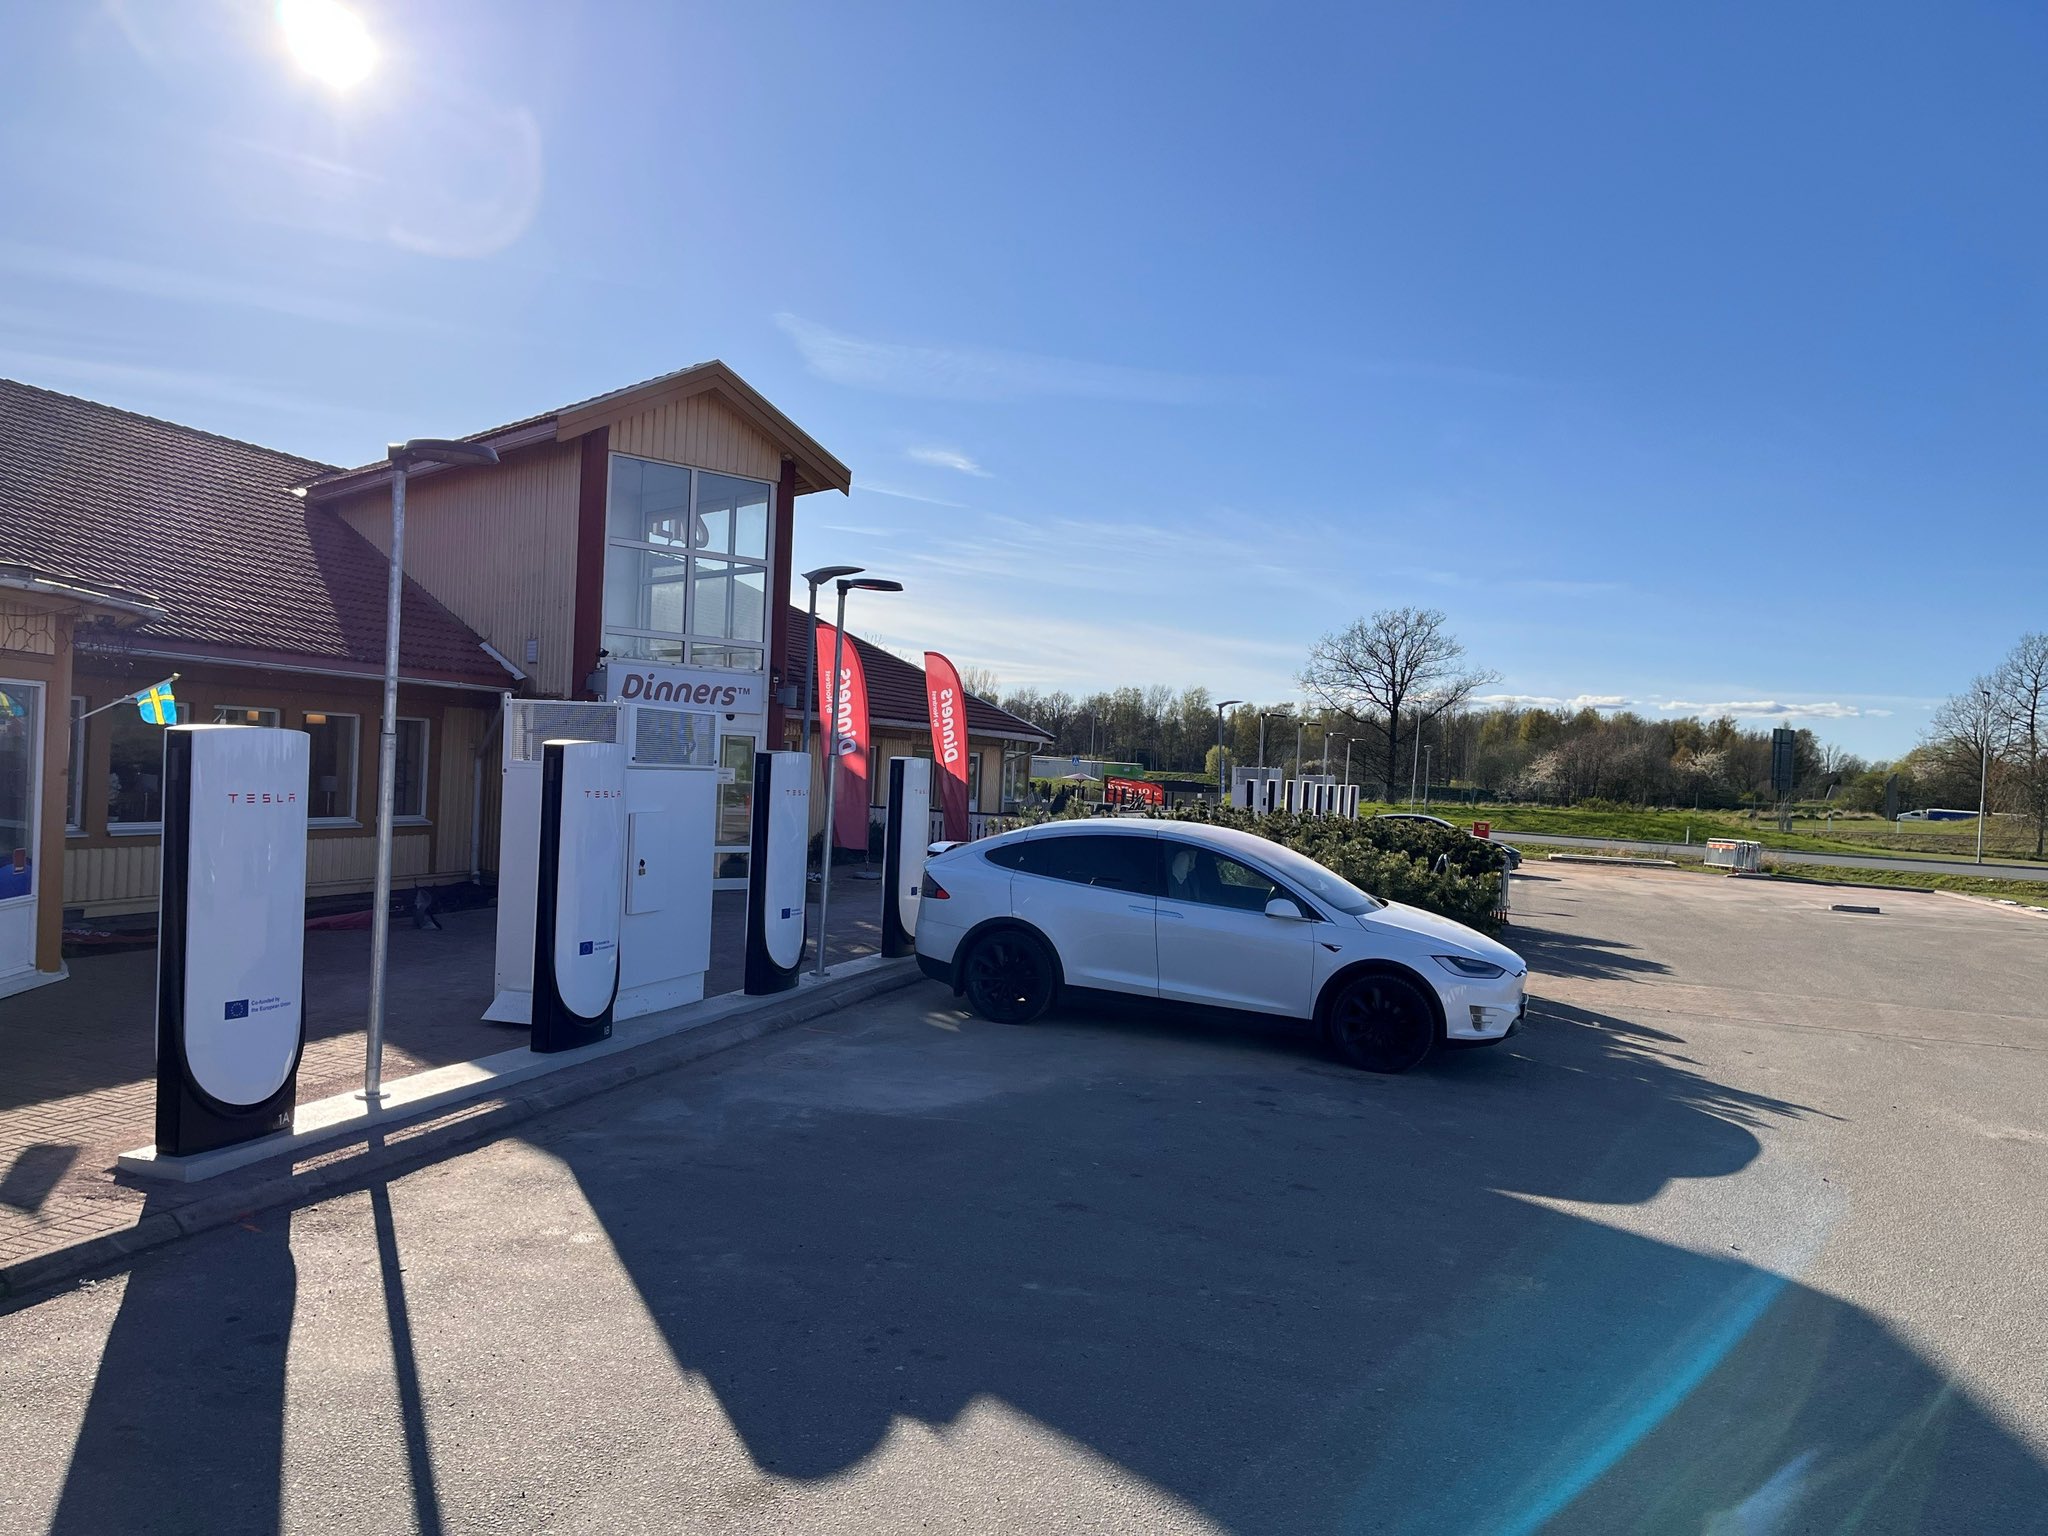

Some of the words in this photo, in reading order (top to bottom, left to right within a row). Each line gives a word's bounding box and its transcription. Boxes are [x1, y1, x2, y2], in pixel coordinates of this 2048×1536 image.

[228, 793, 296, 804] TESLA
[584, 790, 622, 799] TESLA
[278, 1111, 290, 1126] 1A
